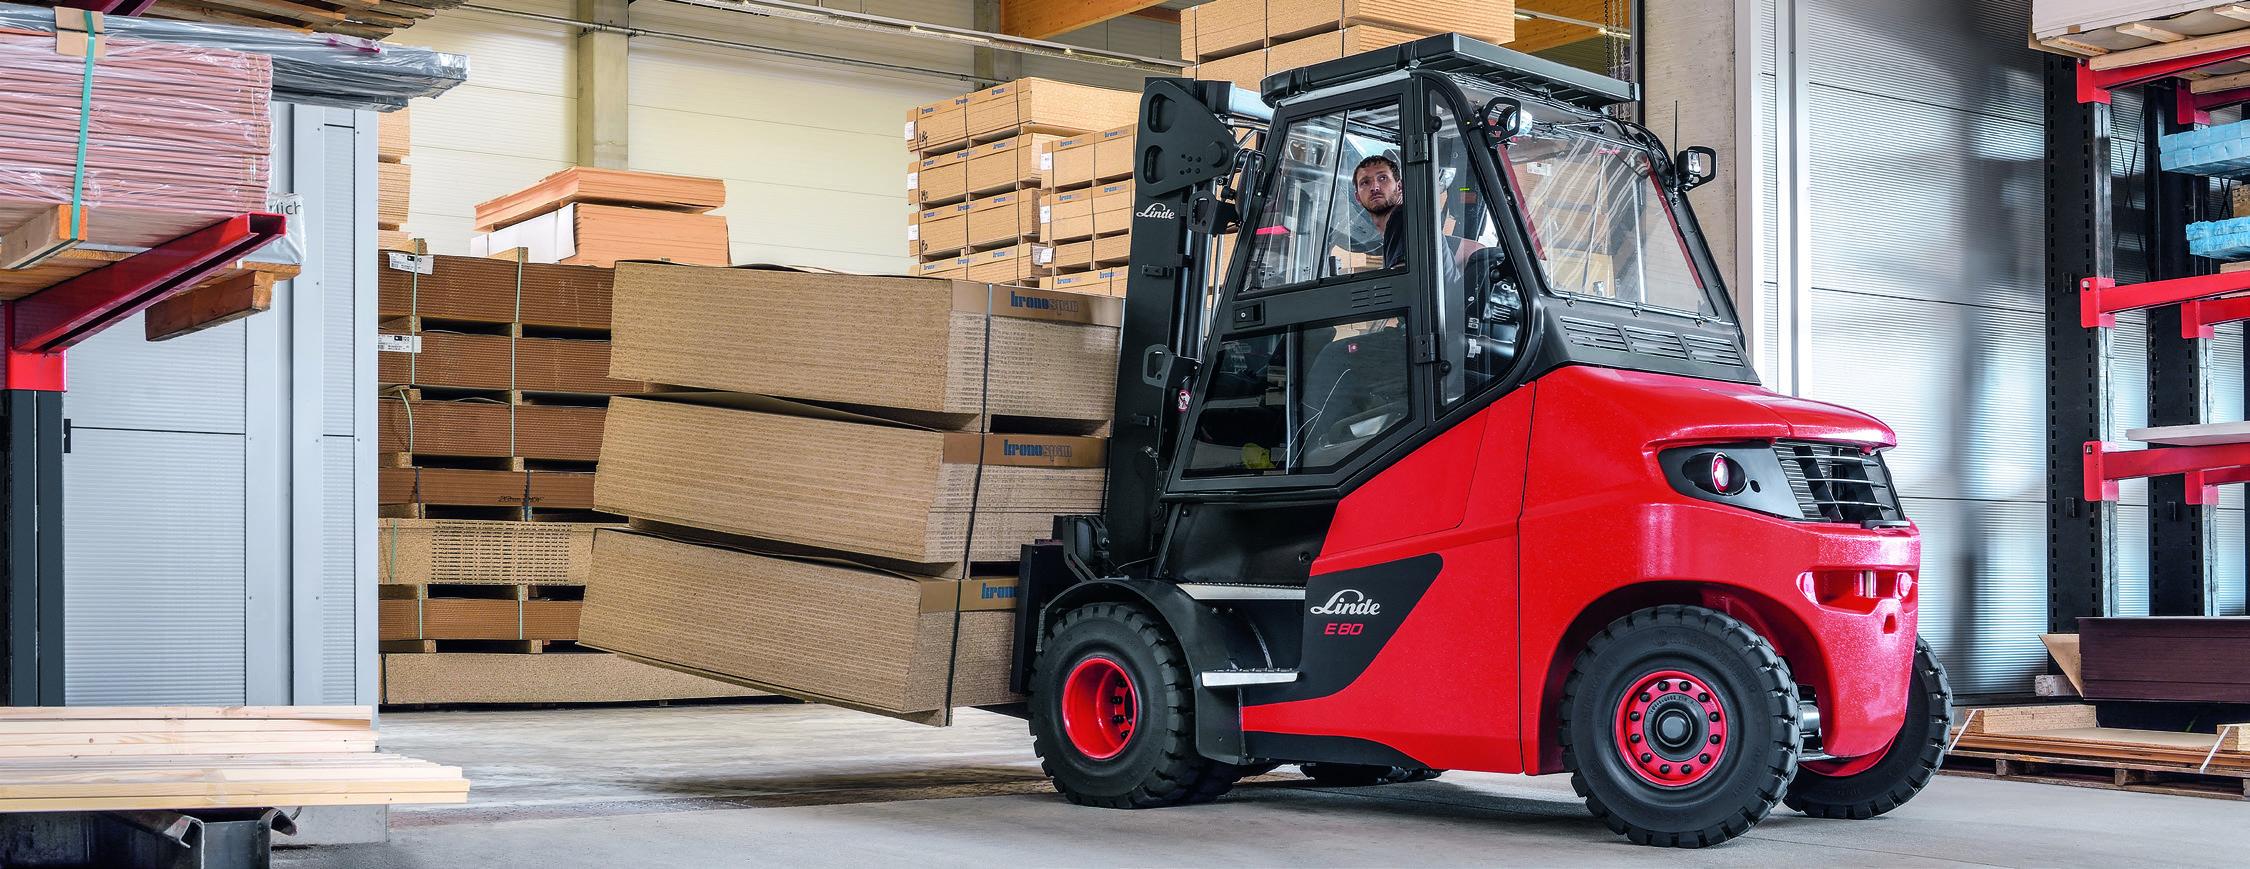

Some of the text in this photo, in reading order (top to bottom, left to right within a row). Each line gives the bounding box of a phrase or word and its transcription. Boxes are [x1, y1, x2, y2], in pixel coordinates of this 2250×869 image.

[1136, 202, 1175, 219] Linde
[1310, 589, 1381, 616] Linde
[1324, 623, 1364, 635] E 80
